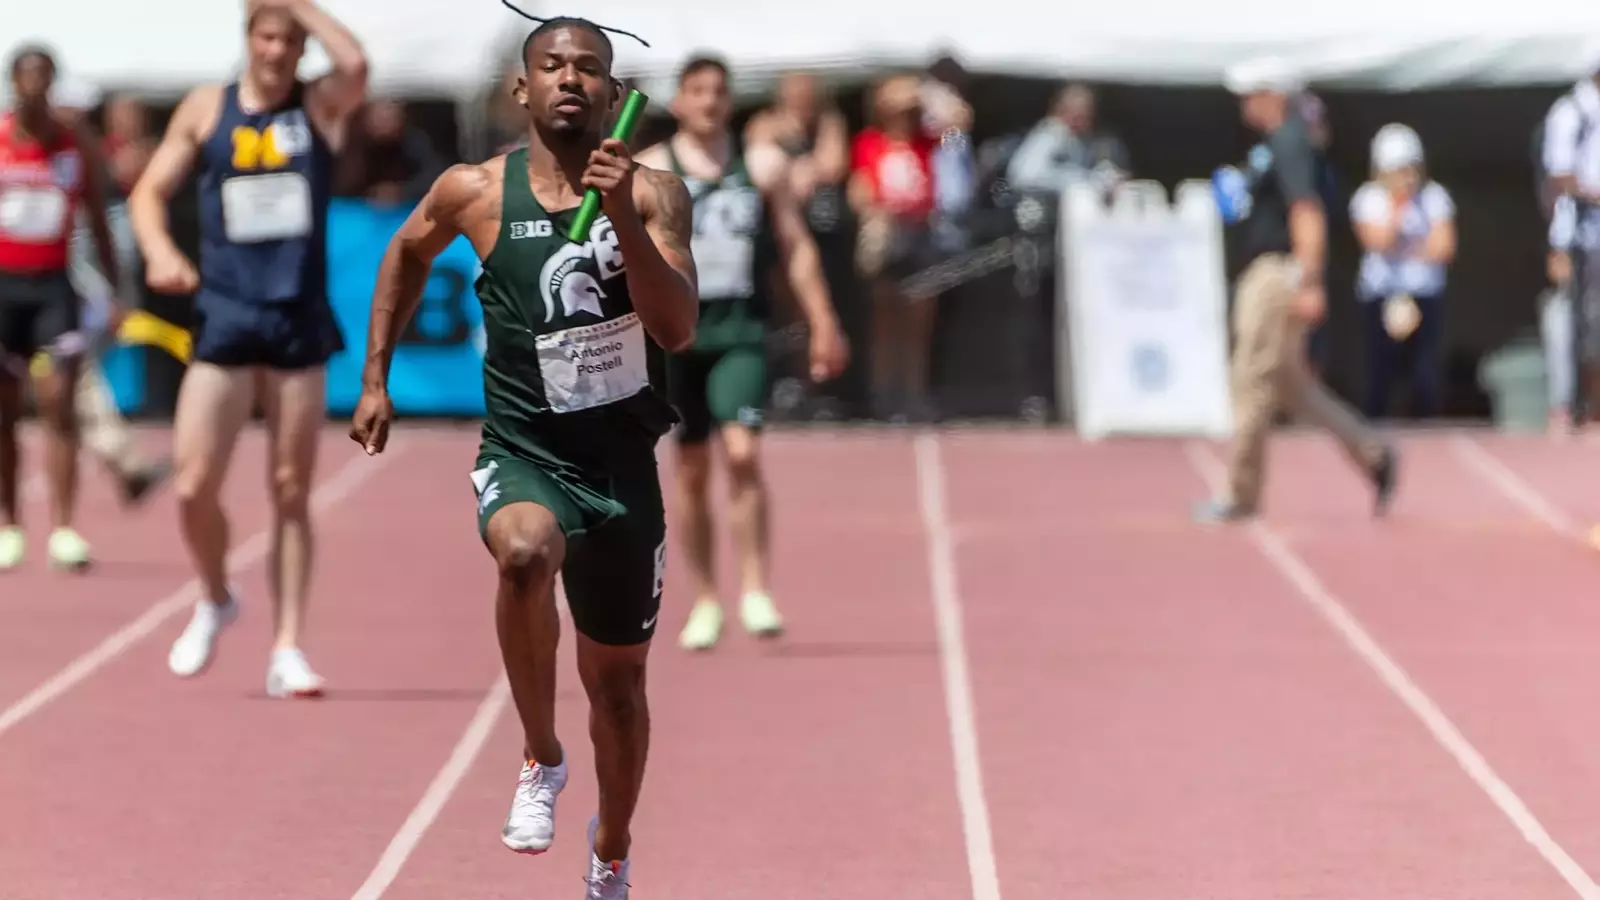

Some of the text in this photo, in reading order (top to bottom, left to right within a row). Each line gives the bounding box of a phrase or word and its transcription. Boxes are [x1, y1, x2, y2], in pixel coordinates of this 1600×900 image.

[510, 220, 552, 239] BIG
[571, 341, 623, 360] Antonio
[577, 356, 623, 376] Postell
